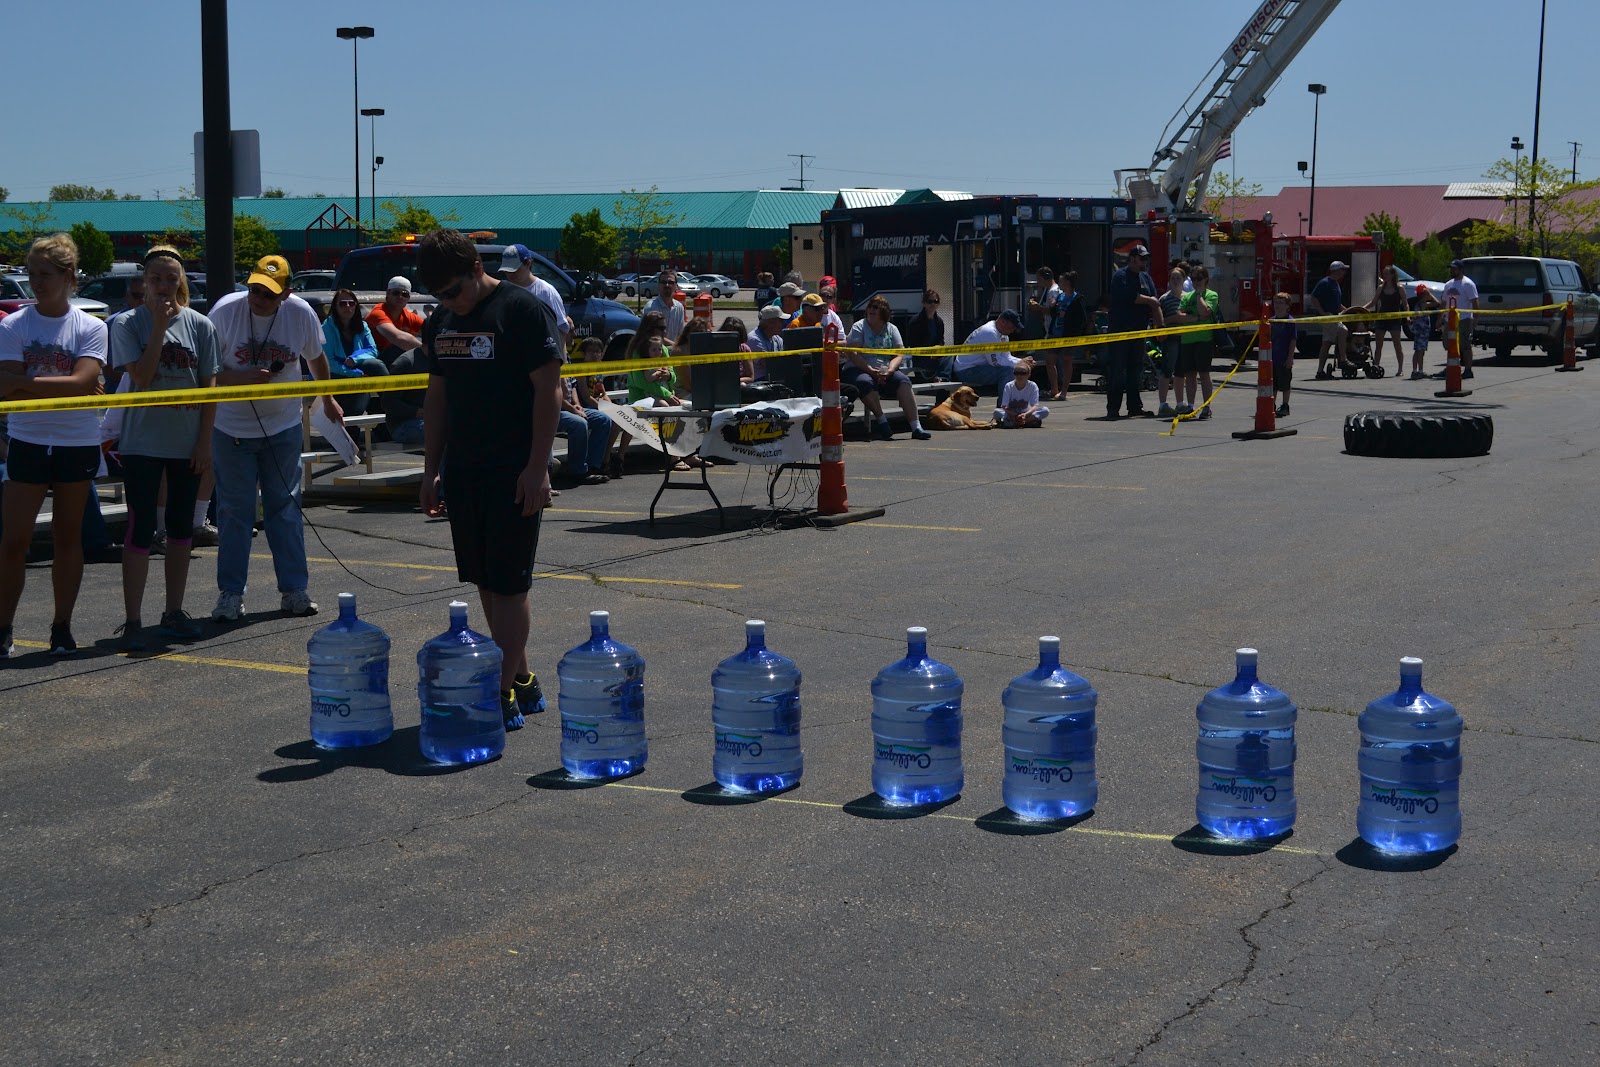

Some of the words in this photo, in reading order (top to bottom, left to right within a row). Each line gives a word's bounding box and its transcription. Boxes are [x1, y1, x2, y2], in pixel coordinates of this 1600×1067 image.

[1232, 0, 1282, 56] ROTHSCH
[863, 236, 911, 251] ROTHSCHILD
[872, 254, 920, 268] AMBULANCE
[738, 422, 785, 442] WDEZ
[877, 745, 931, 769] Culligan
[1212, 778, 1277, 803] Culligan
[1371, 788, 1439, 815] Culligan
